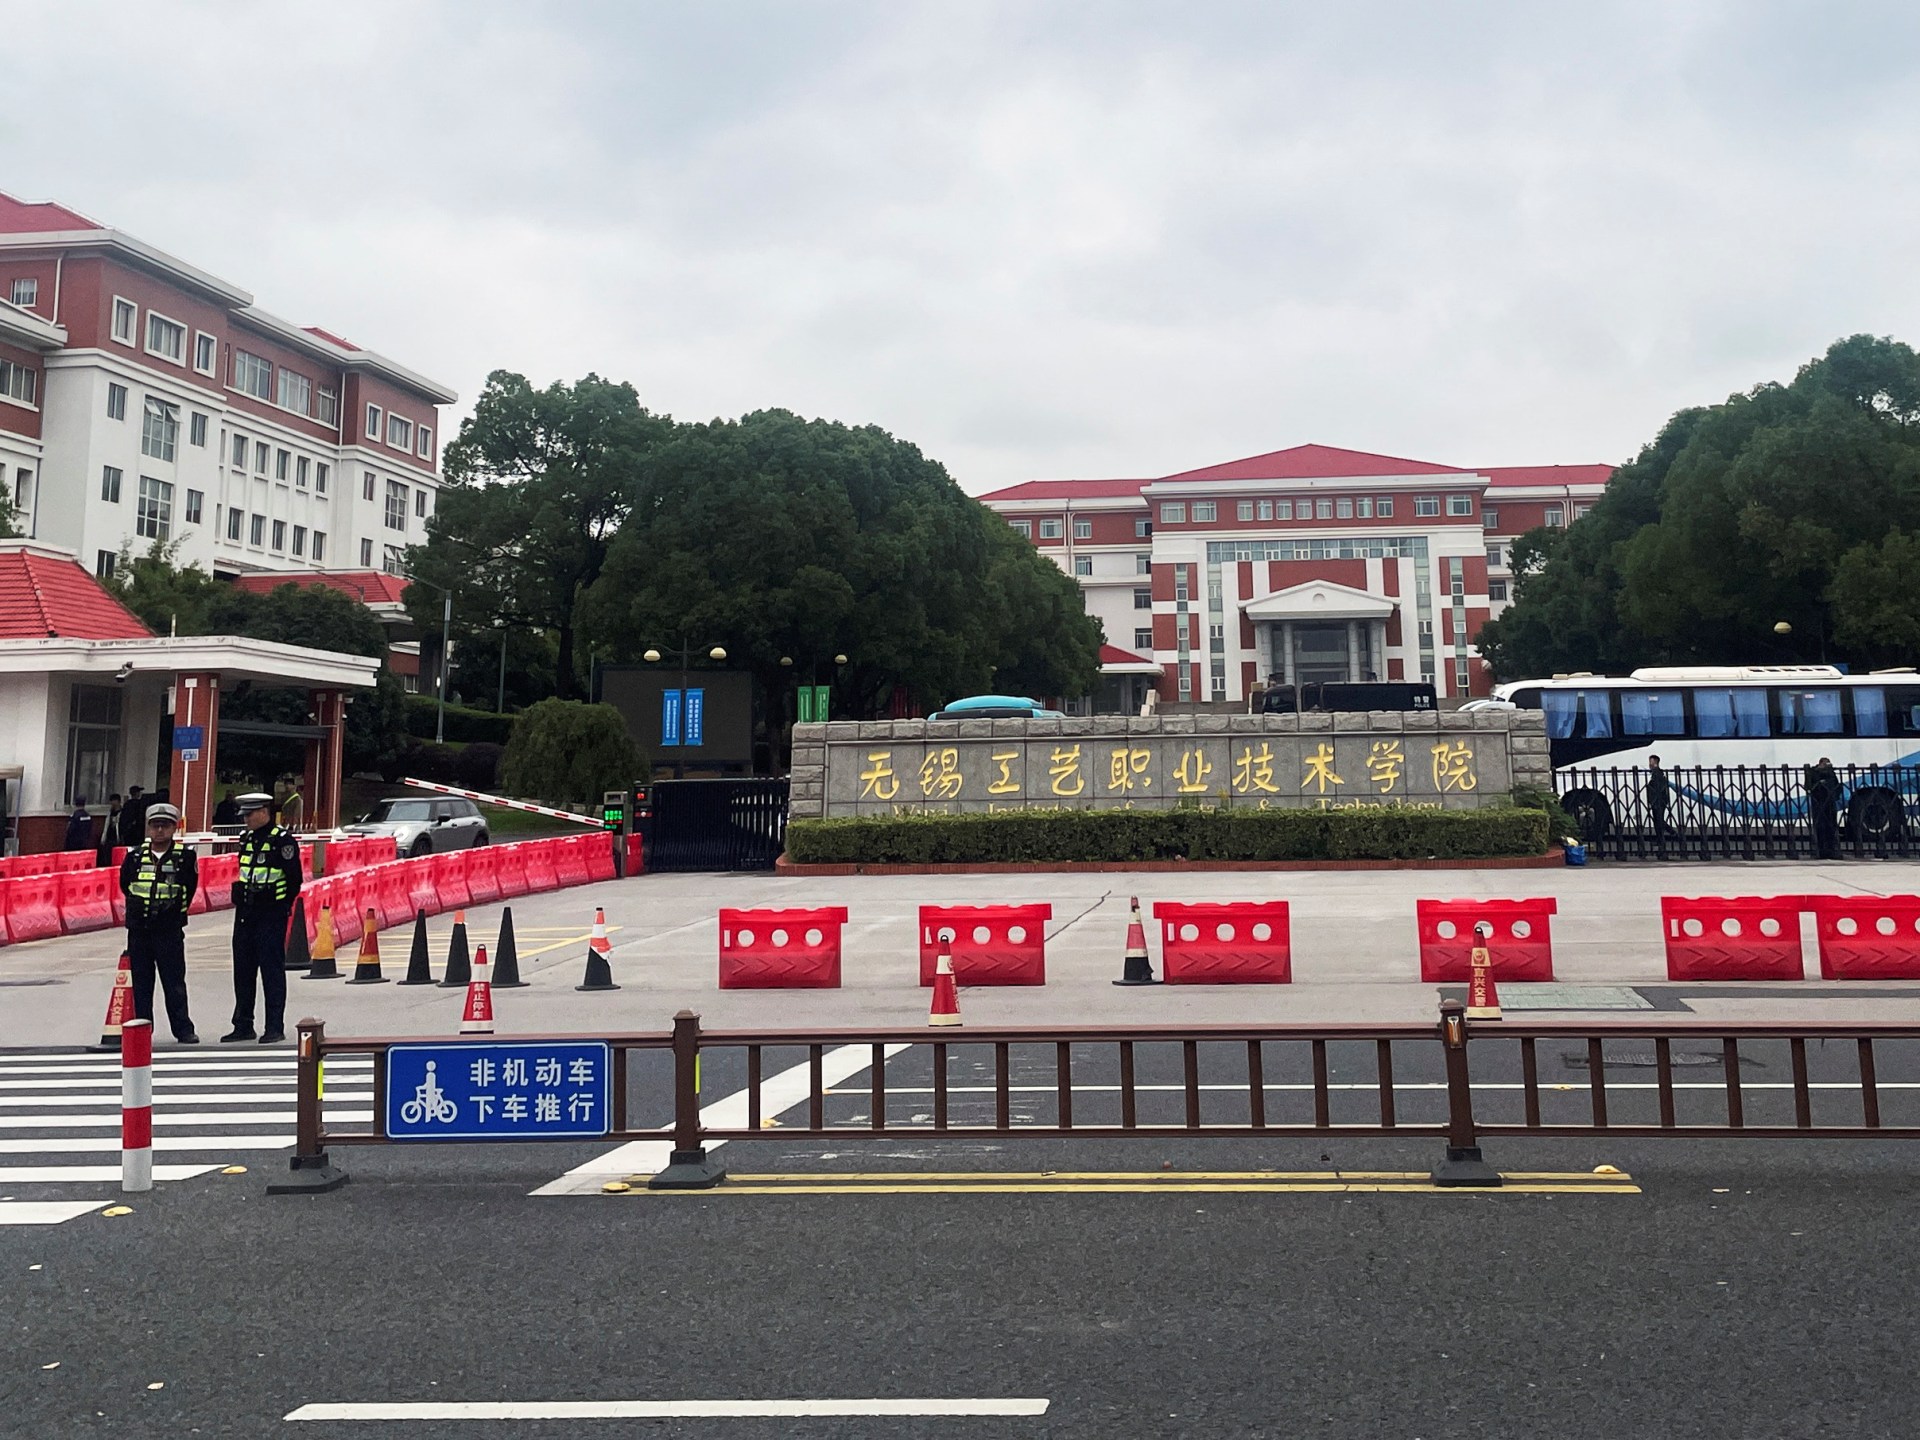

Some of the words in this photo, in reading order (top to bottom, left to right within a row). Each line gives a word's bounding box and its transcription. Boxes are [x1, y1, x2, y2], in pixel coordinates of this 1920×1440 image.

[860, 740, 1477, 799] 无锡工艺职业技术学院
[1315, 797, 1443, 811] Technlo
[470, 1058, 595, 1087] 非机动车
[469, 1093, 595, 1123] 下车推行
